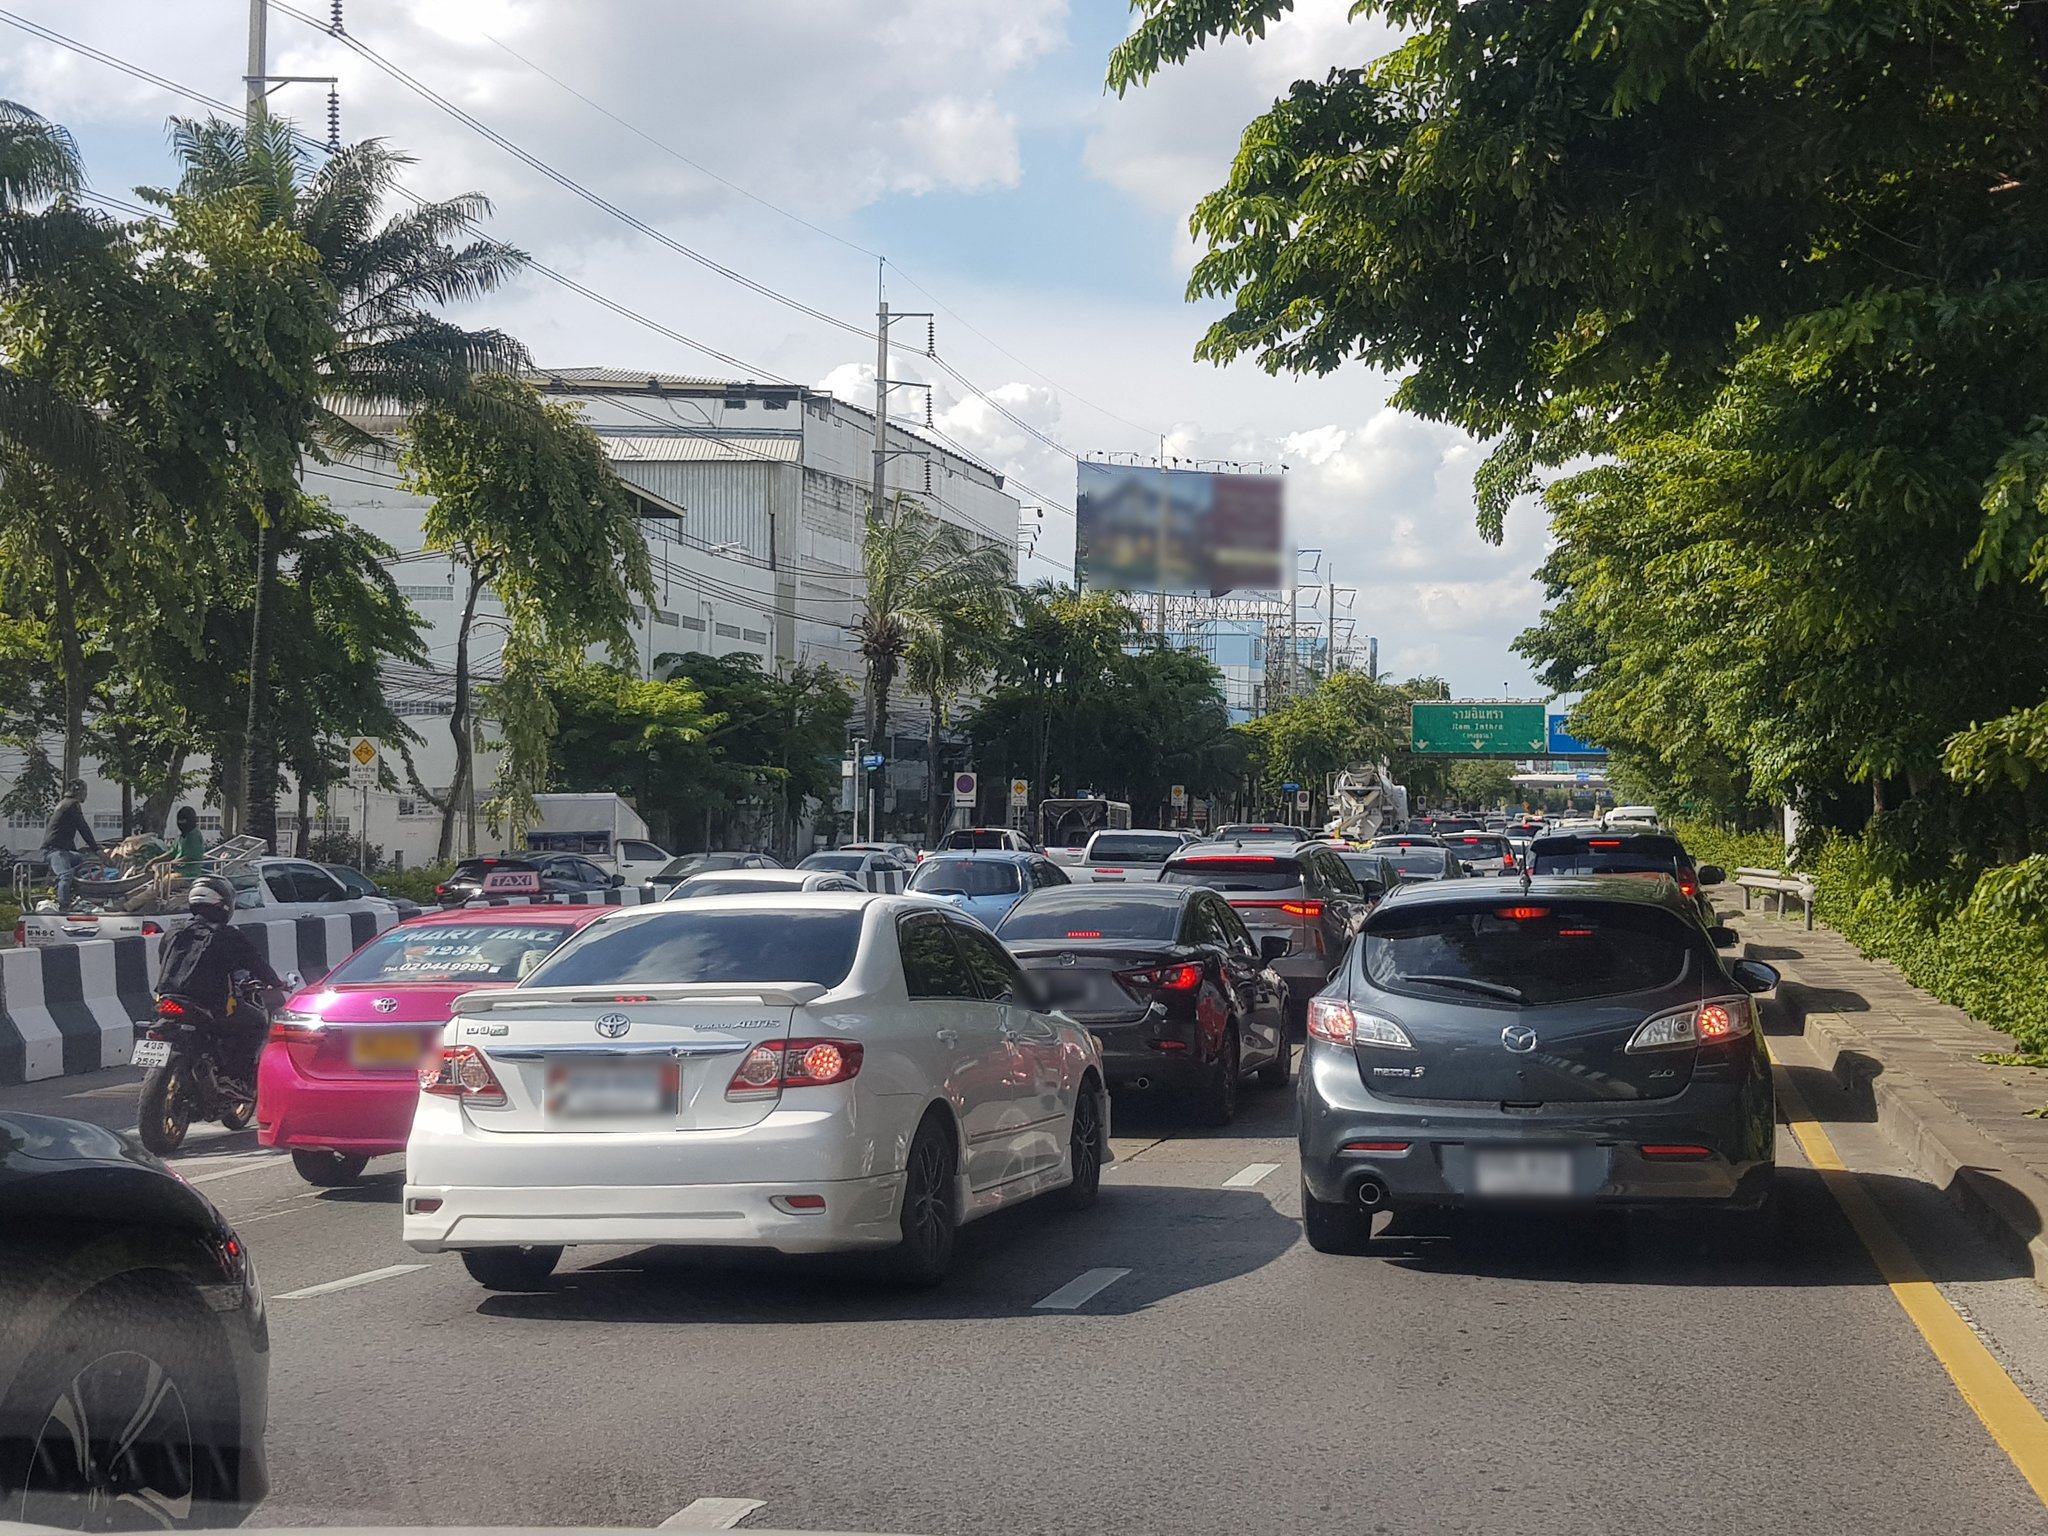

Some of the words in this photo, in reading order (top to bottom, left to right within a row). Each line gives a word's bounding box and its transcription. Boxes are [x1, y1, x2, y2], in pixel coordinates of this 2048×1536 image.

[1452, 706, 1504, 720] รามอินทรา
[494, 876, 531, 886] TAXI
[382, 928, 484, 944] SMART
[487, 929, 563, 941] TAXI
